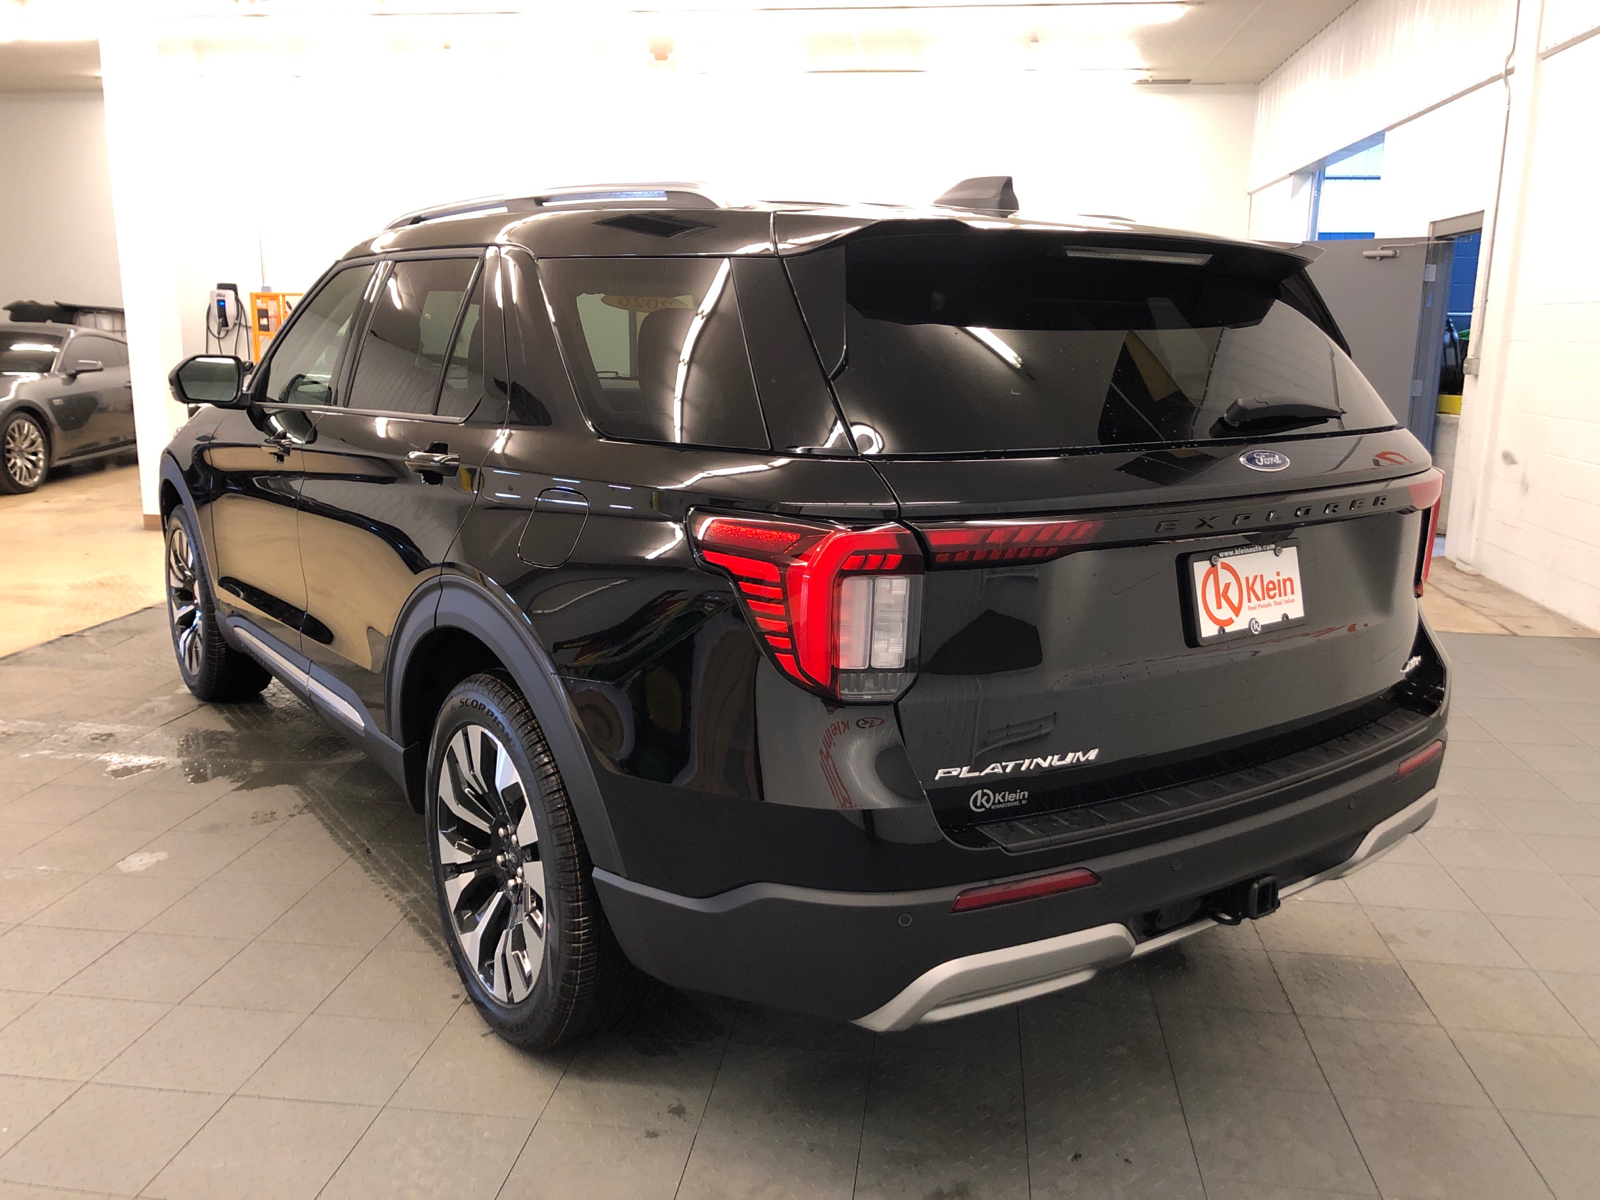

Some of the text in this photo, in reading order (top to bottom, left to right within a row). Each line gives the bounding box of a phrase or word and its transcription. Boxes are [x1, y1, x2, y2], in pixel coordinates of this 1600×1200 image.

[1254, 452, 1282, 465] Ford
[1155, 495, 1386, 532] EXPLORER
[1219, 544, 1275, 557] www.kleinauto.com
[1245, 571, 1294, 602] Klein
[459, 698, 513, 744] SCORPION
[934, 748, 1100, 780] PLATINUM
[995, 789, 1028, 803] Klein
